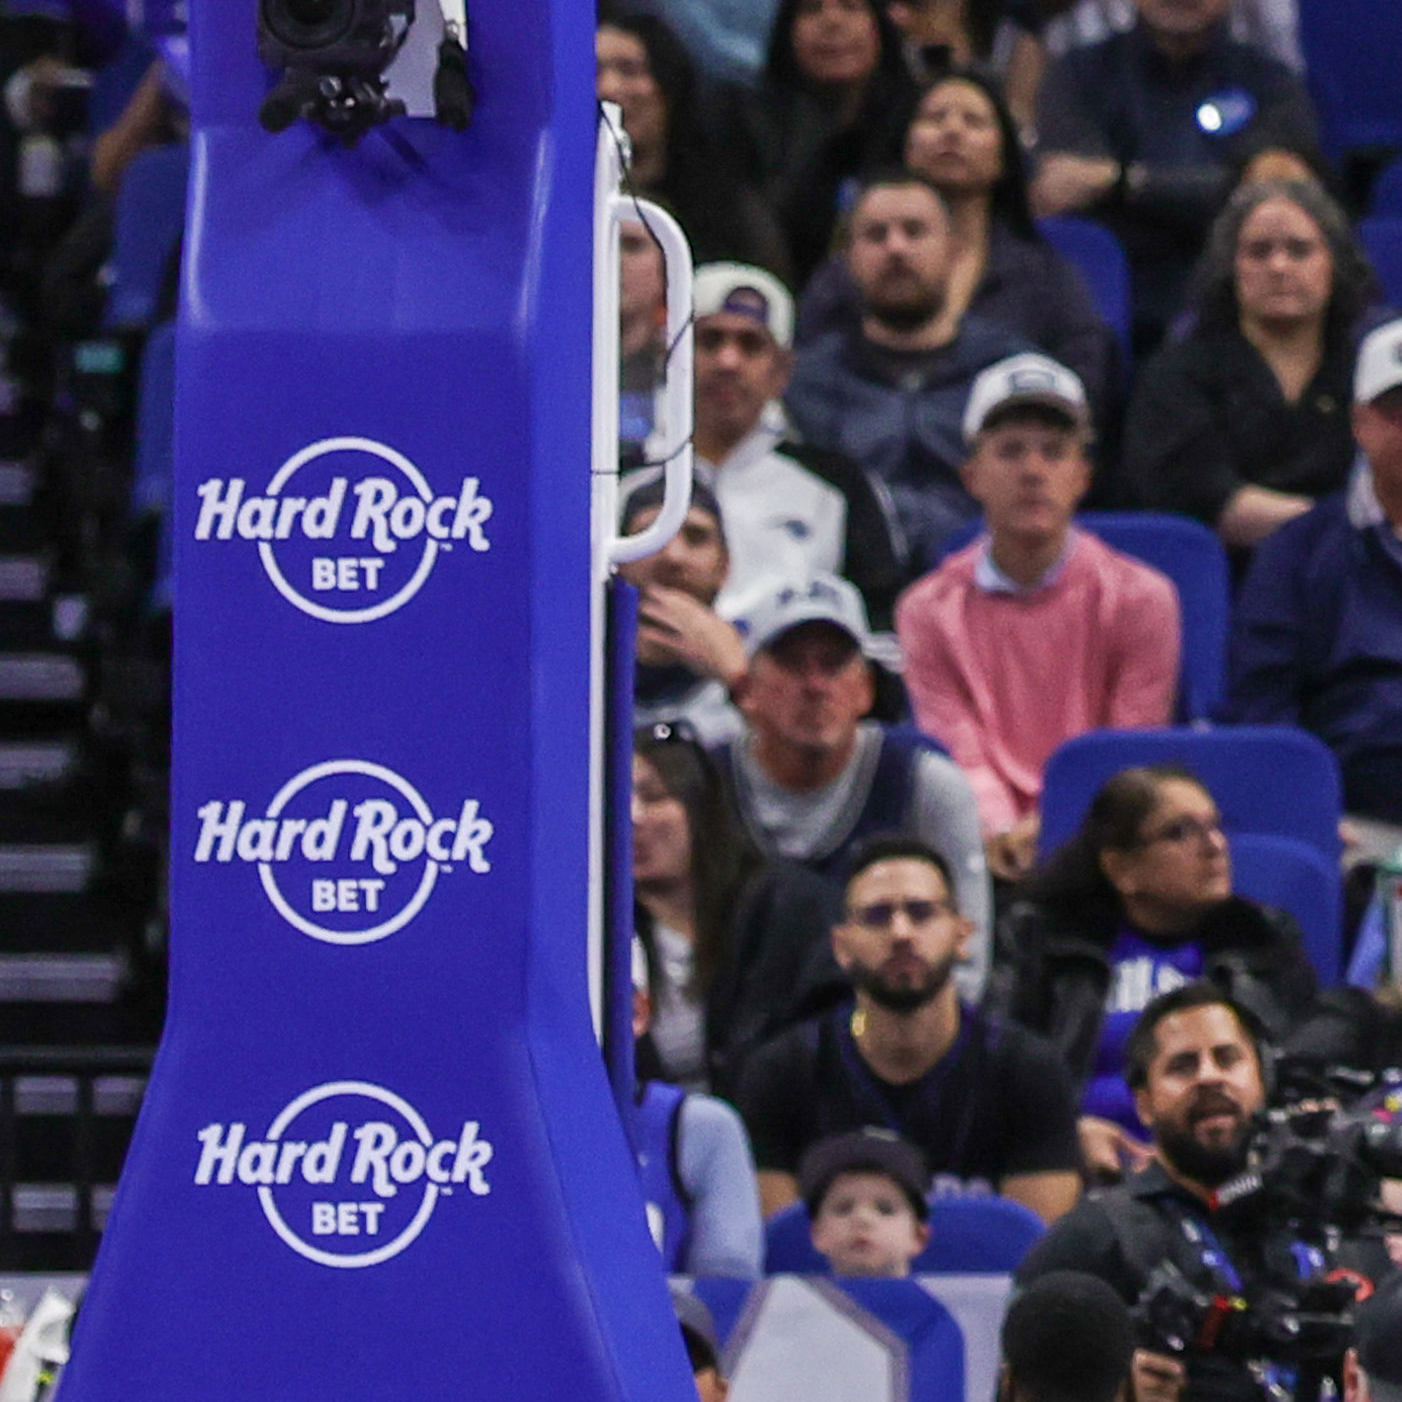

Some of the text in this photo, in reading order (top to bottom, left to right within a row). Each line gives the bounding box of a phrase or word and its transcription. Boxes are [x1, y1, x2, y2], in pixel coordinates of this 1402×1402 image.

[194, 476, 493, 554] Hard Rock
[312, 556, 386, 591] BET
[194, 798, 494, 875] Hard Rock
[312, 878, 386, 913] BET
[194, 1120, 493, 1198] Hard Rock
[312, 1201, 386, 1236] BET
